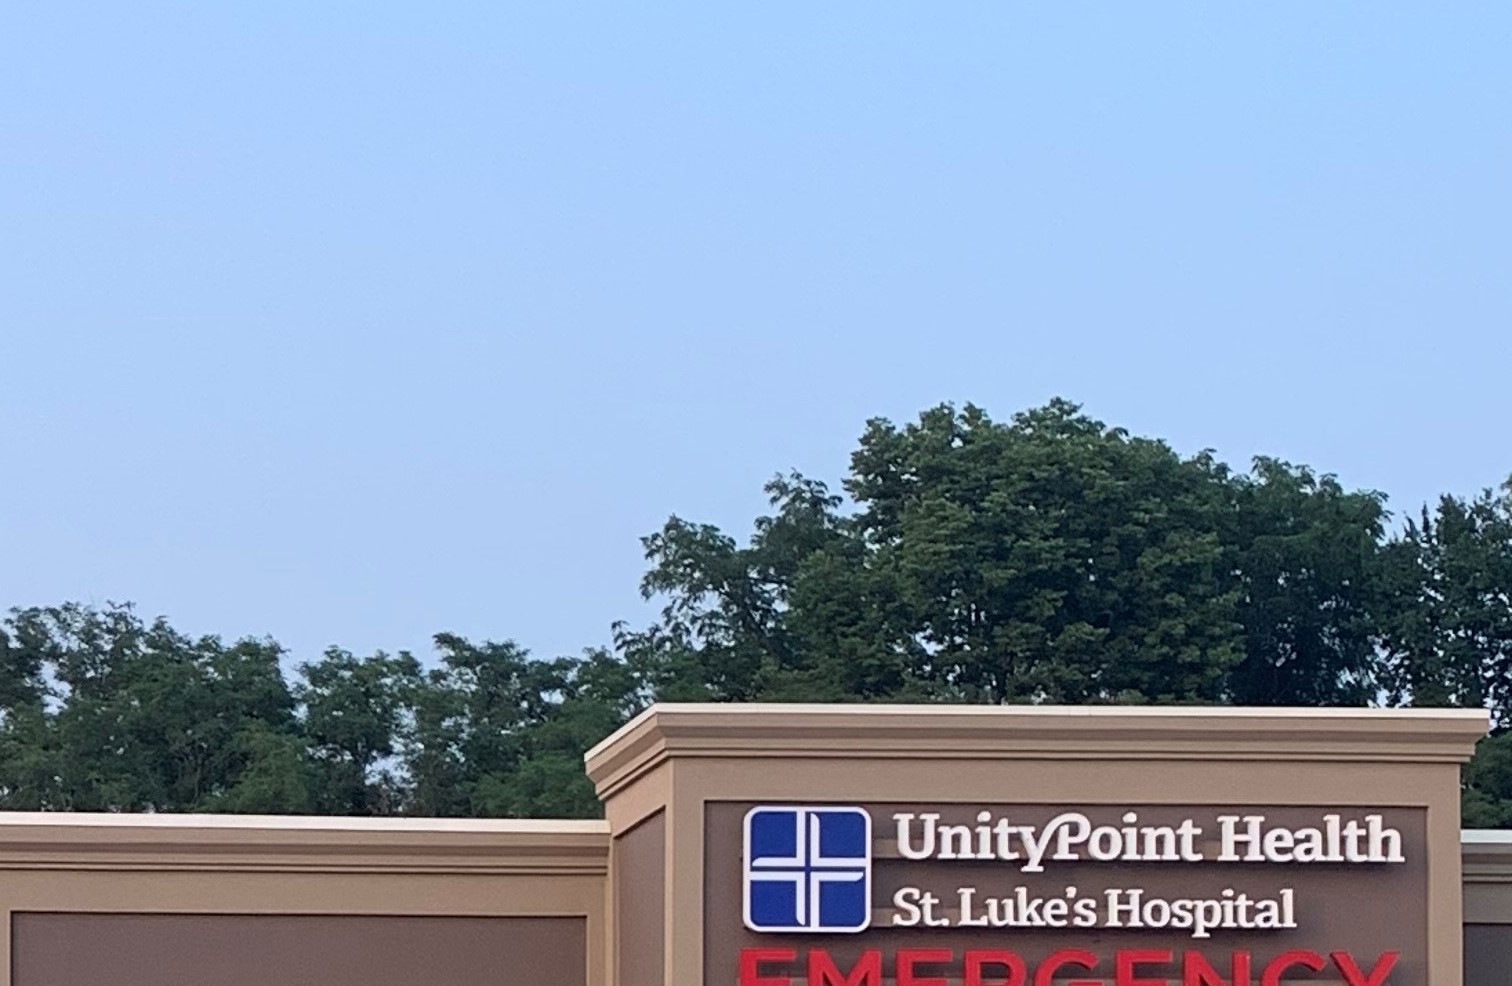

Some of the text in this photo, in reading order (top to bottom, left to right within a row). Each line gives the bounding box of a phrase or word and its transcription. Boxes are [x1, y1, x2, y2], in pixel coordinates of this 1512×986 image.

[892, 811, 1405, 872] UnityPoint Health
[892, 886, 1299, 938] St. Luke's Hospital
